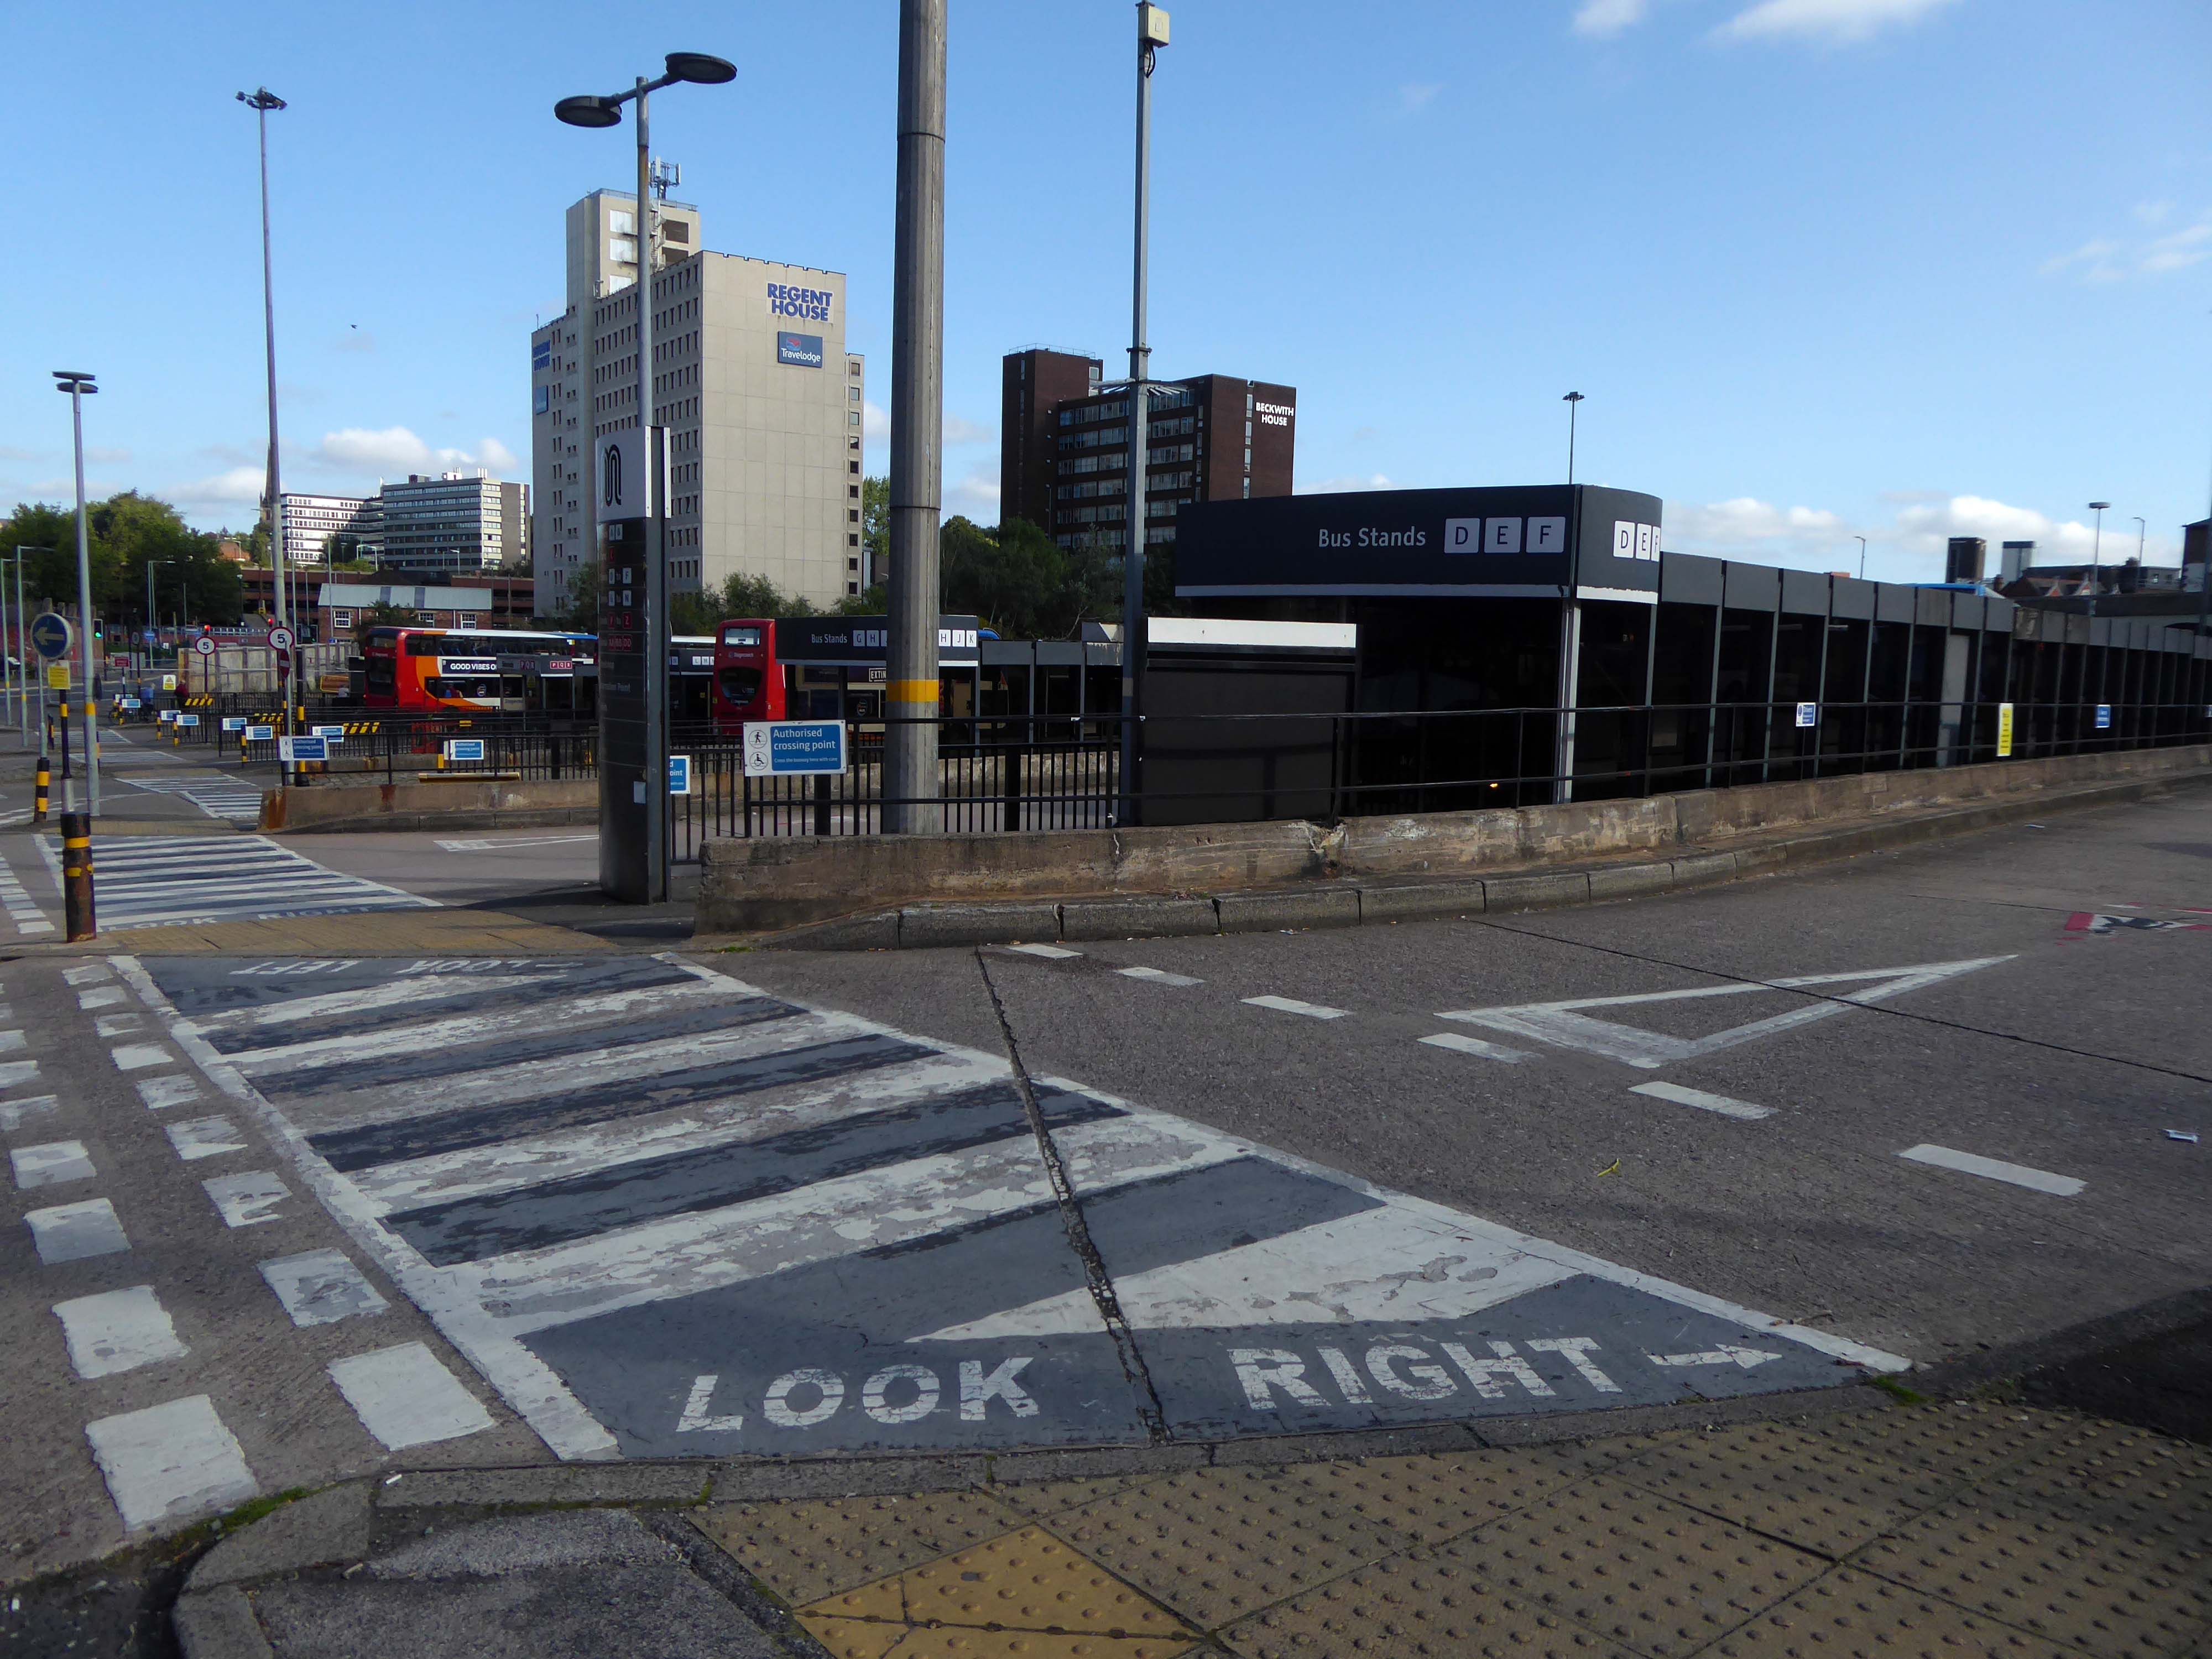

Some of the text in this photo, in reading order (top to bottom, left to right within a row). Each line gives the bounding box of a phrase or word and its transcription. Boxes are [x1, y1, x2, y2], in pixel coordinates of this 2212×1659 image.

[768, 283, 832, 307] REGENT
[772, 299, 828, 321] HOUSE
[781, 348, 821, 363] Travelodge
[1256, 402, 1294, 416] BECKWITH
[1261, 414, 1287, 426] HOUSE
[1318, 525, 1552, 547] Bus Stands D E F
[1621, 530, 1658, 553] D E F
[277, 634, 286, 644] 5
[811, 634, 823, 643] Bus
[824, 633, 848, 643] Stands
[857, 634, 862, 643] G
[870, 634, 875, 643] H
[941, 633, 973, 643] H J K
[202, 641, 210, 650] 5
[774, 728, 822, 738] Authorised
[774, 740, 836, 752] crossing point
[1227, 1337, 1623, 1411] RIGHT
[676, 1357, 1040, 1432] LOOK
